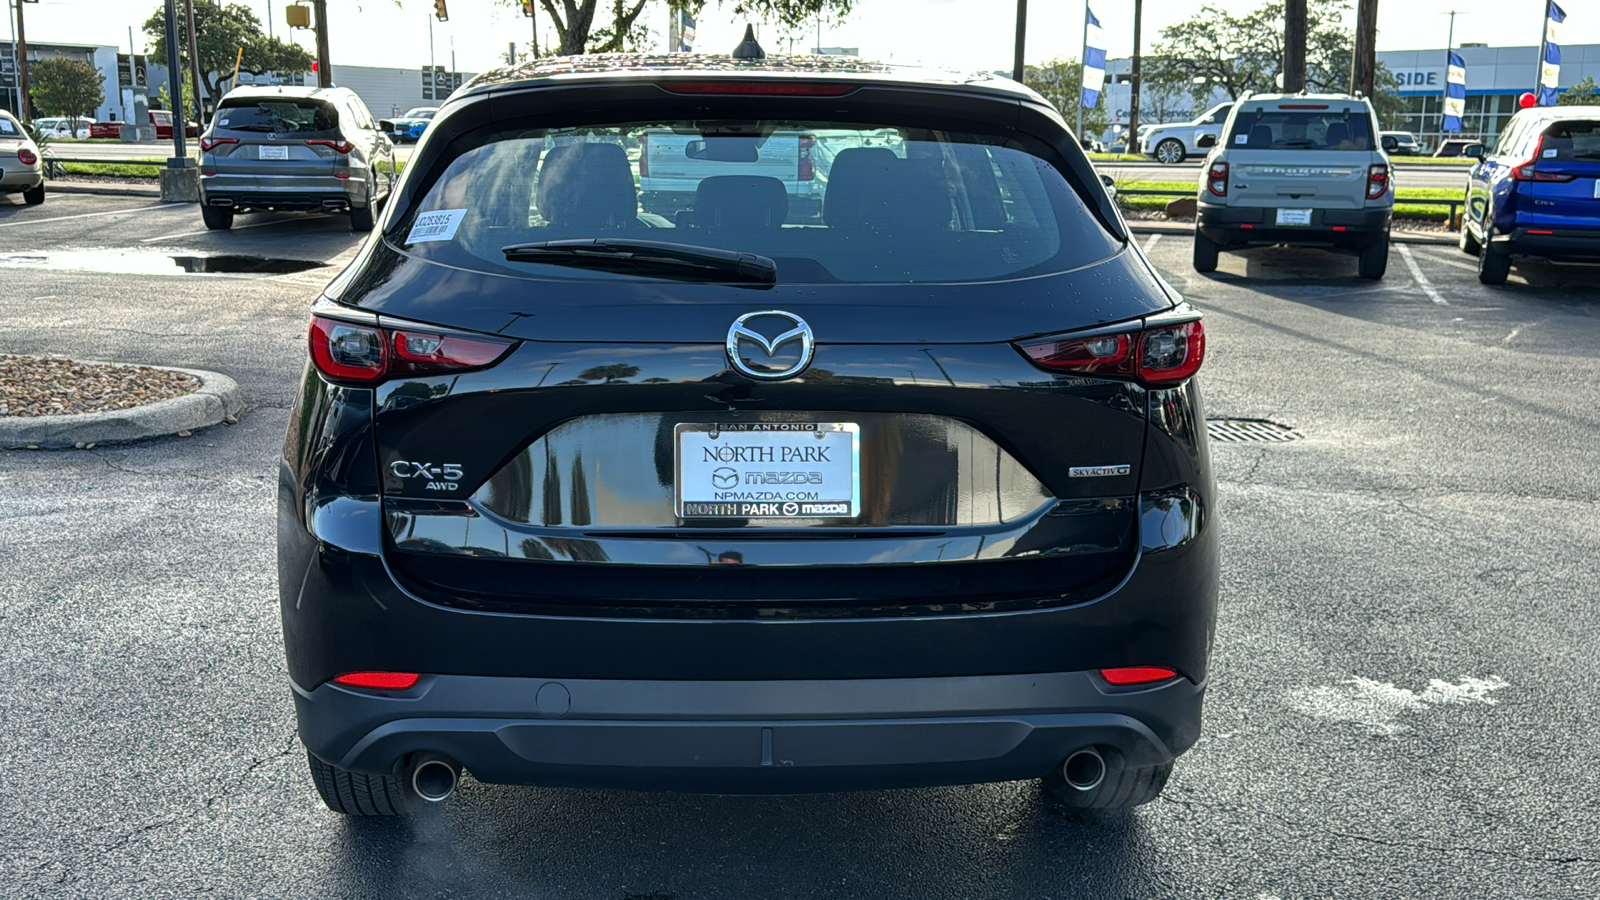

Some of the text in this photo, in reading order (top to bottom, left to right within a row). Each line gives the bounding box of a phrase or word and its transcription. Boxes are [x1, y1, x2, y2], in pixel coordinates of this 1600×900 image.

[1390, 72, 1437, 86] SIDE
[702, 446, 831, 463] NORTH PARK
[390, 460, 464, 480] CX-5
[745, 471, 823, 485] mazda
[425, 481, 459, 491] AWD
[714, 491, 819, 501] NPMAZDA.COM
[687, 503, 848, 515] NORTH PARK mazda
